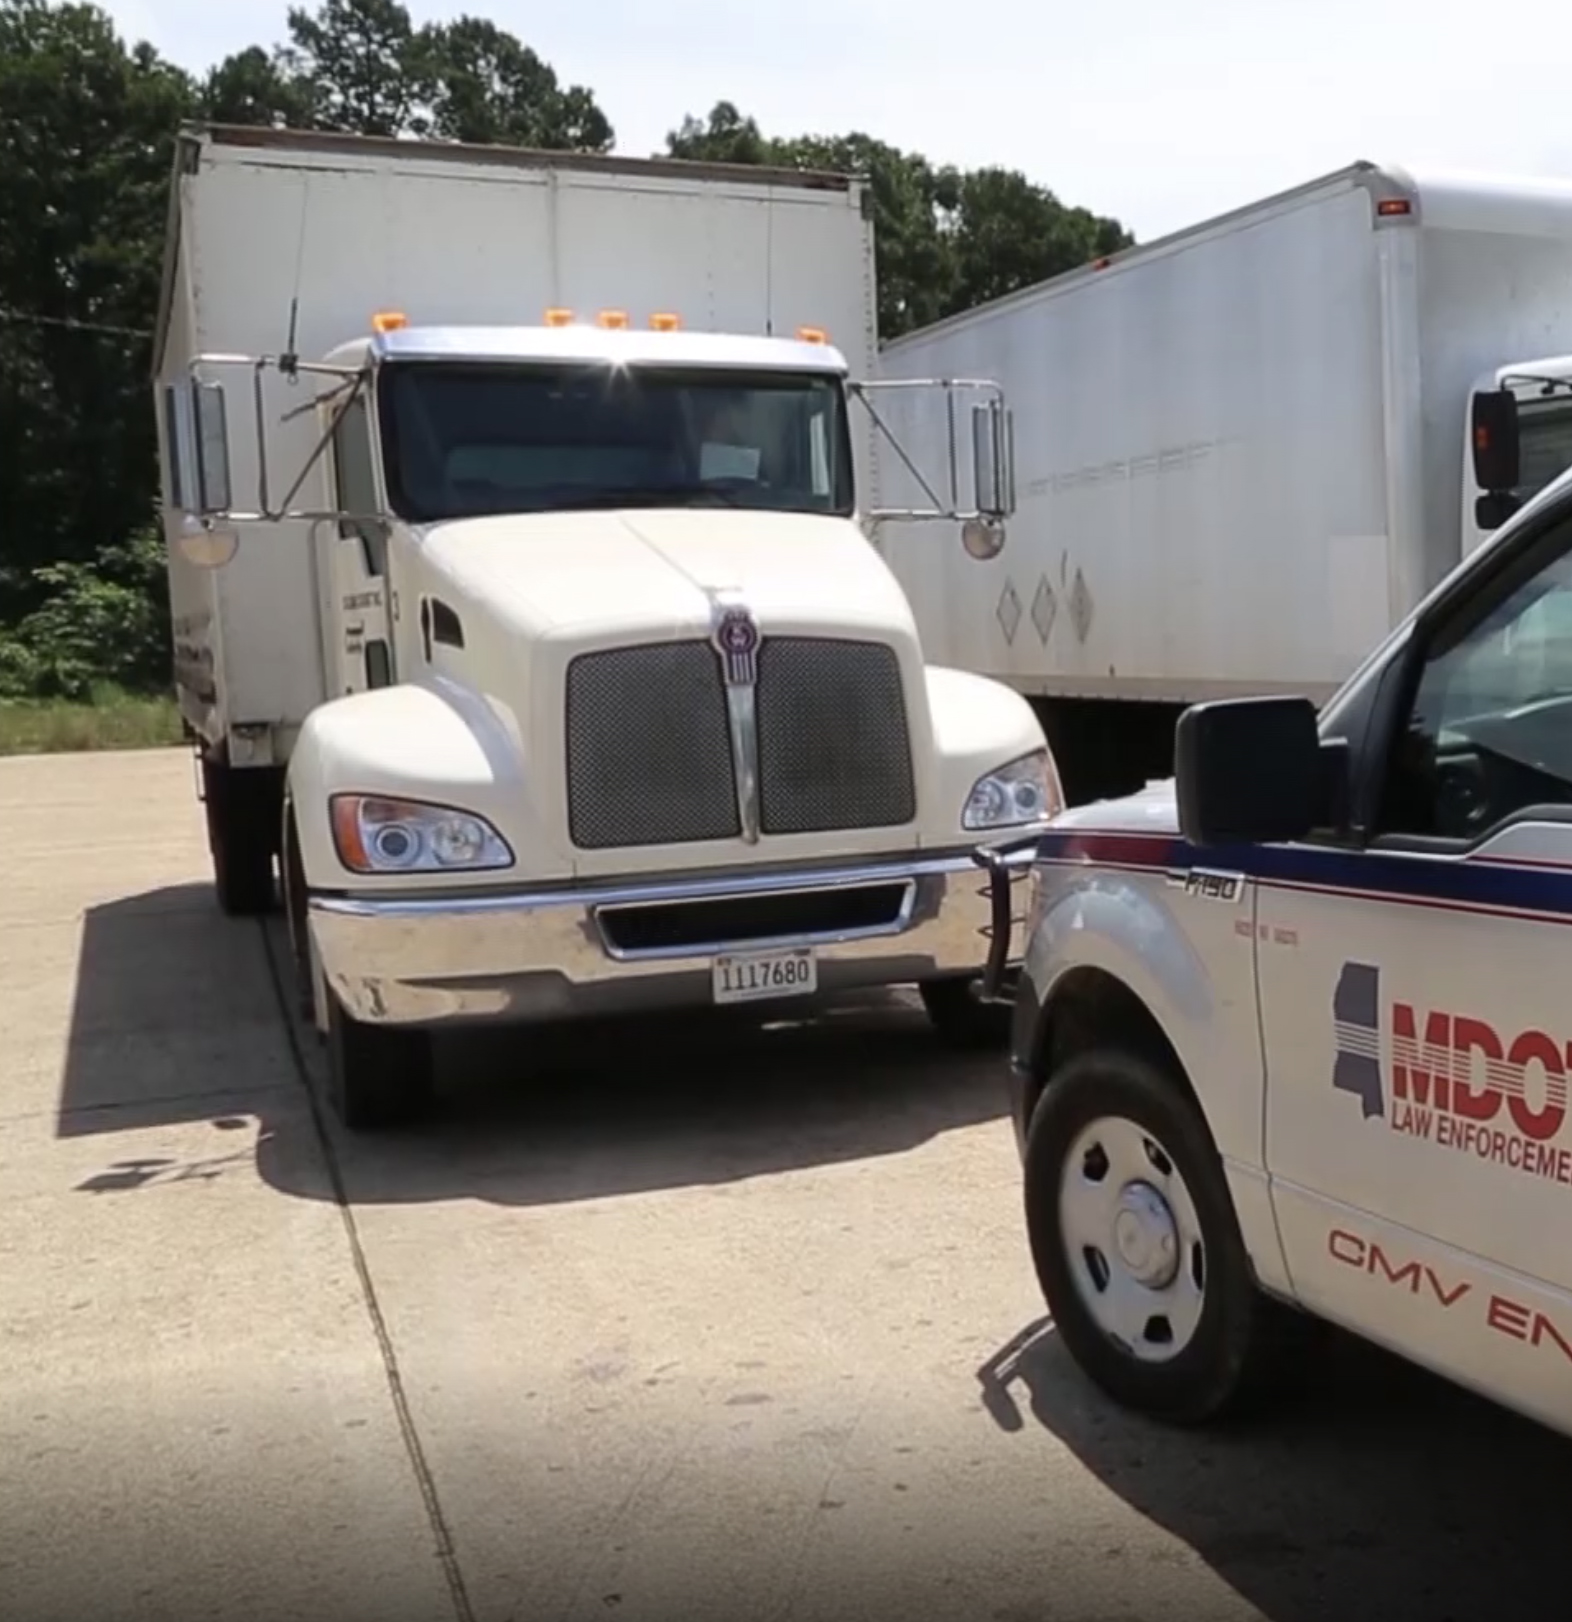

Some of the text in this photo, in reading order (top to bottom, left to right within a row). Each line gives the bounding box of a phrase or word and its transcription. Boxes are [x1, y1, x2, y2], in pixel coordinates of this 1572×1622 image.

[722, 960, 809, 991] 1117680
[1391, 1103, 1432, 1138] LAW
[1329, 1229, 1472, 1307] CMV
